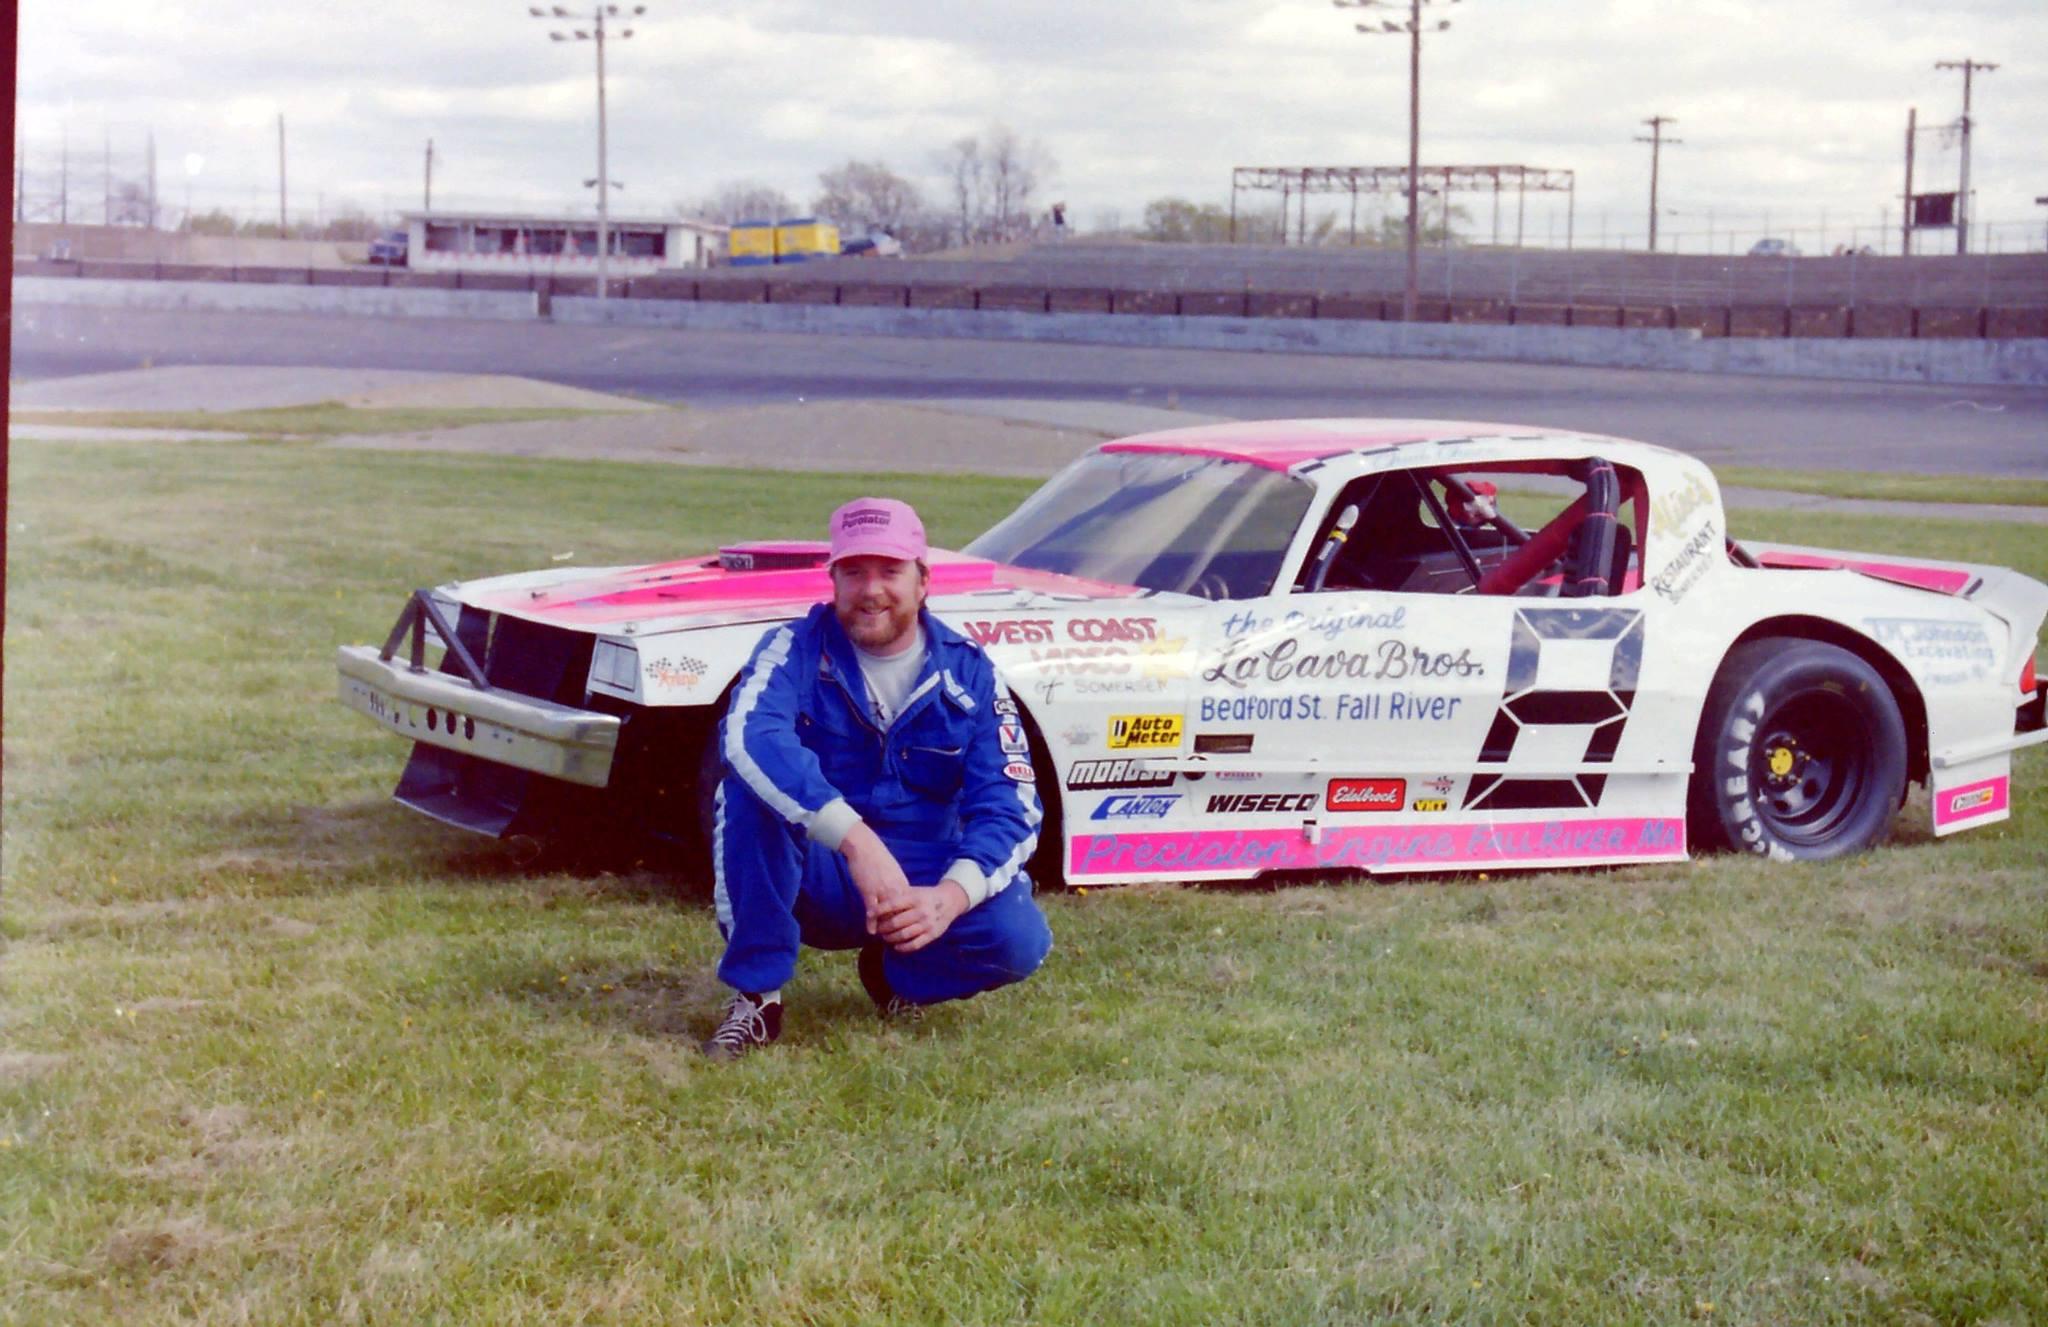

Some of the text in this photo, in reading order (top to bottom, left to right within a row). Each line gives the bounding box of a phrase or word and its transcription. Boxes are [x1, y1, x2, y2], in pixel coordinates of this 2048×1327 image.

[963, 618, 1157, 647] WEST COAST
[1223, 610, 1274, 638] the
[1374, 639, 1485, 680] Bros.
[1035, 676, 1064, 704] of
[1200, 691, 1461, 722] Bedford St. Fall River
[1460, 608, 1645, 811] 8
[1131, 717, 1173, 730] Auto
[1127, 731, 1180, 745] Meter
[1206, 793, 1320, 813] WISECO
[1079, 832, 1297, 875] Precision
[1315, 826, 1456, 867] Engine
